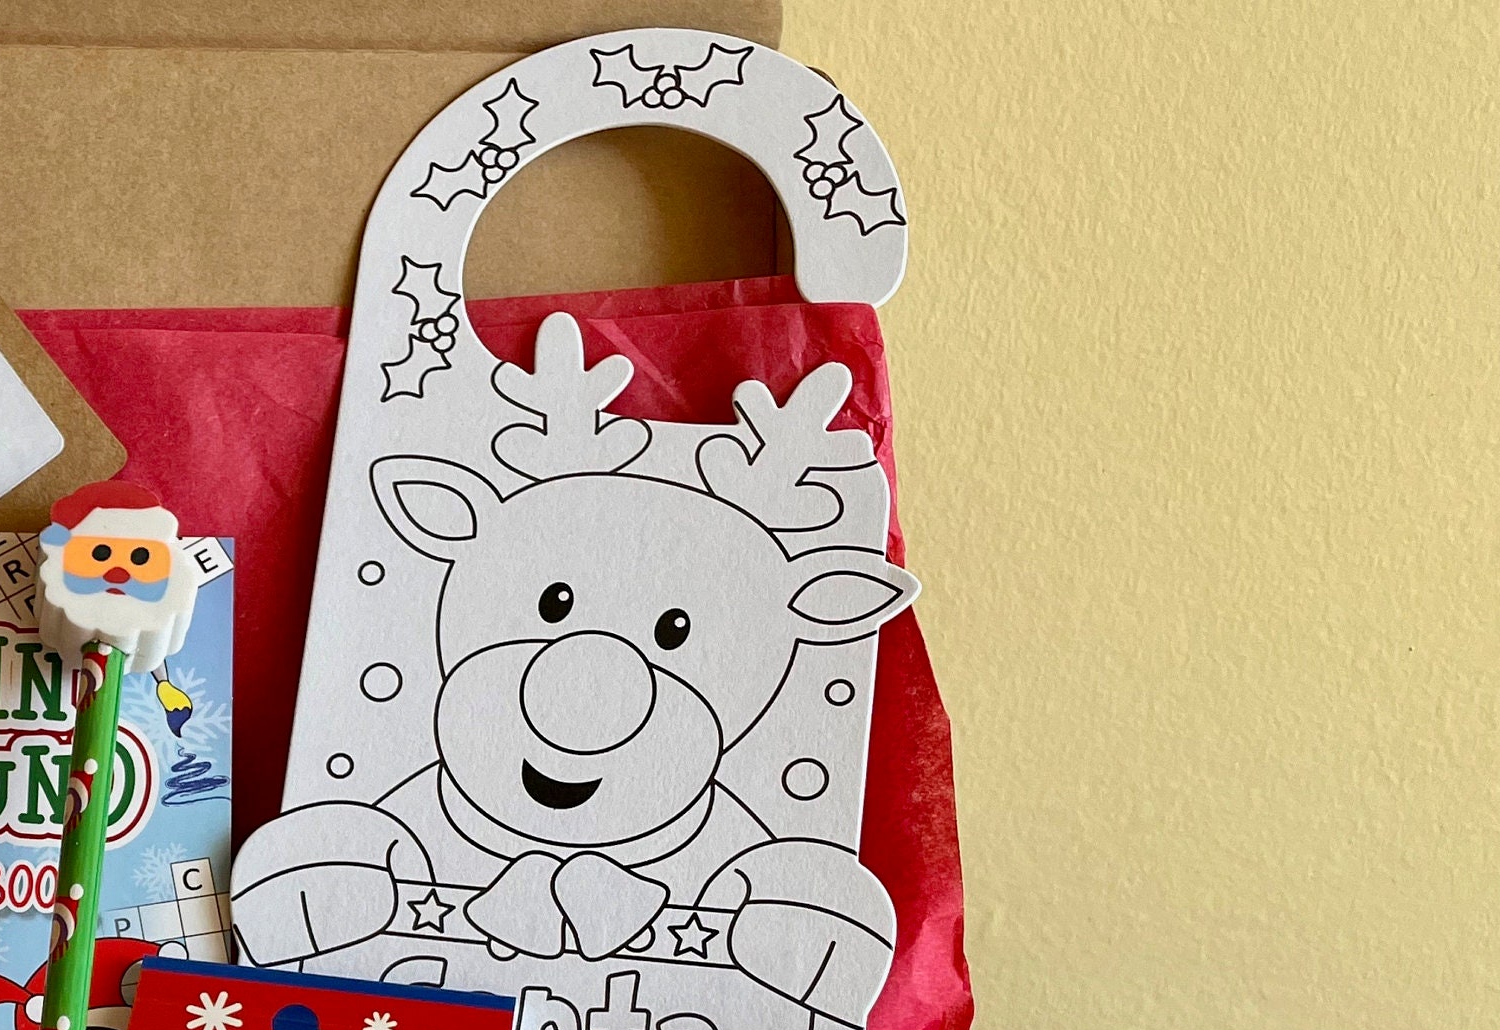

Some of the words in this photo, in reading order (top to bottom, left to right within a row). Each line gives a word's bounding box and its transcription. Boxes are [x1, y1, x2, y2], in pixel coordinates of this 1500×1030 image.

[2, 559, 30, 584] R
[193, 548, 219, 574] E
[182, 868, 203, 891] C
[114, 918, 131, 937] P
